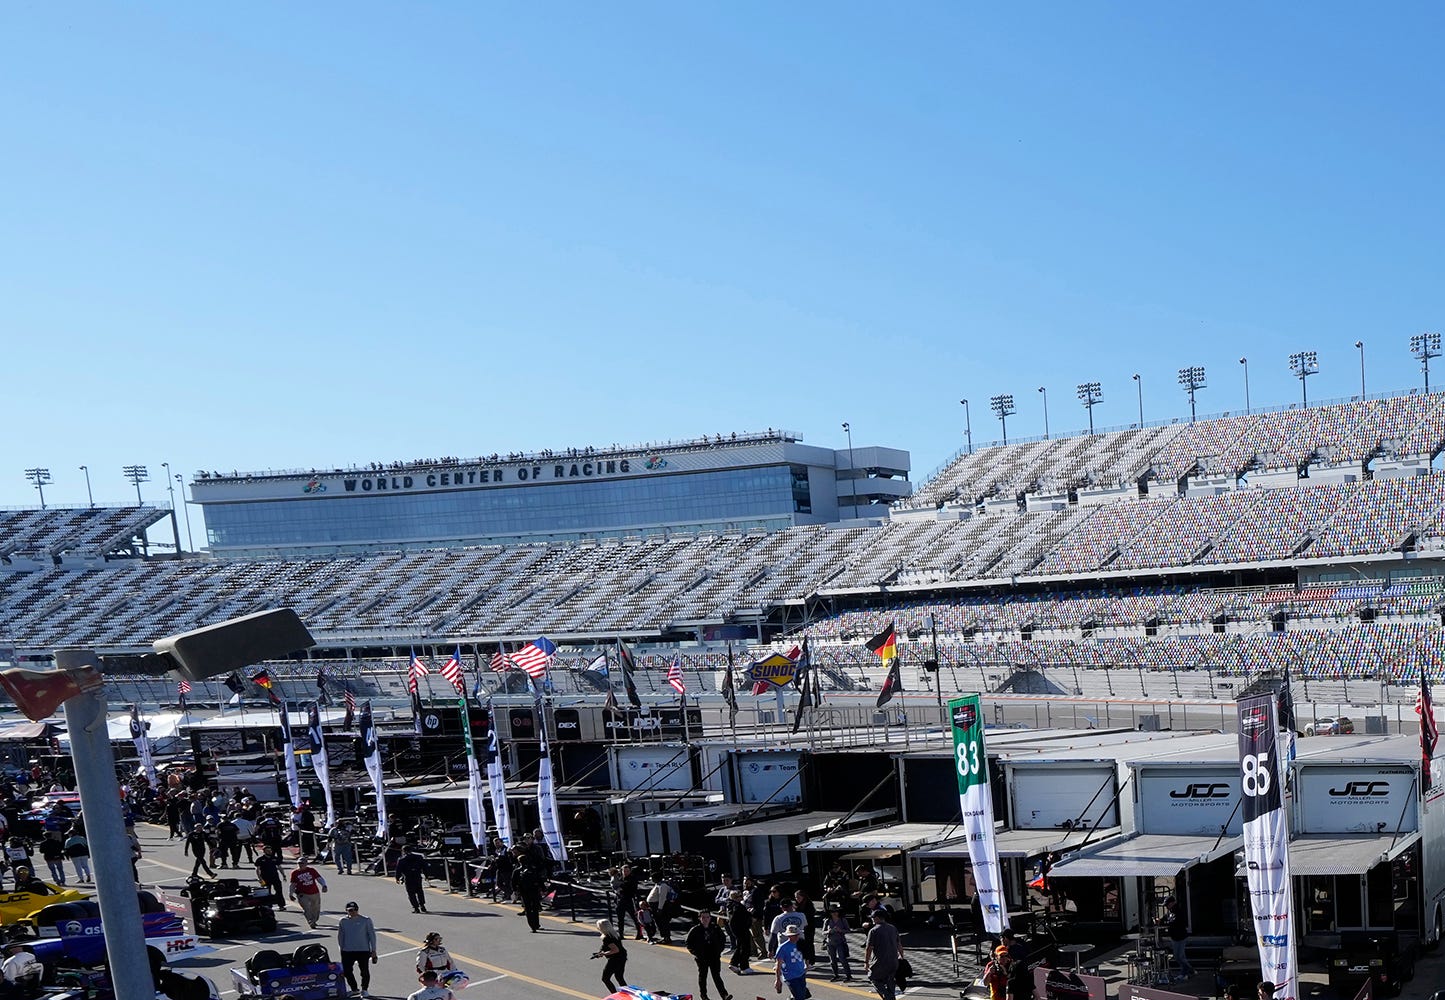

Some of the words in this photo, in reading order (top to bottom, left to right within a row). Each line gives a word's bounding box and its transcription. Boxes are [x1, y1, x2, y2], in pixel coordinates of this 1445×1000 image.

[344, 476, 413, 492] WORLD
[426, 470, 503, 486] CENTER
[518, 467, 541, 481] OF
[554, 460, 631, 477] RACING
[753, 664, 797, 678] SUNOC
[957, 741, 980, 776] 83
[1242, 752, 1270, 797] 85
[1169, 783, 1230, 799] JDC
[1328, 781, 1390, 797] JDC
[281, 984, 309, 995] ACURA
